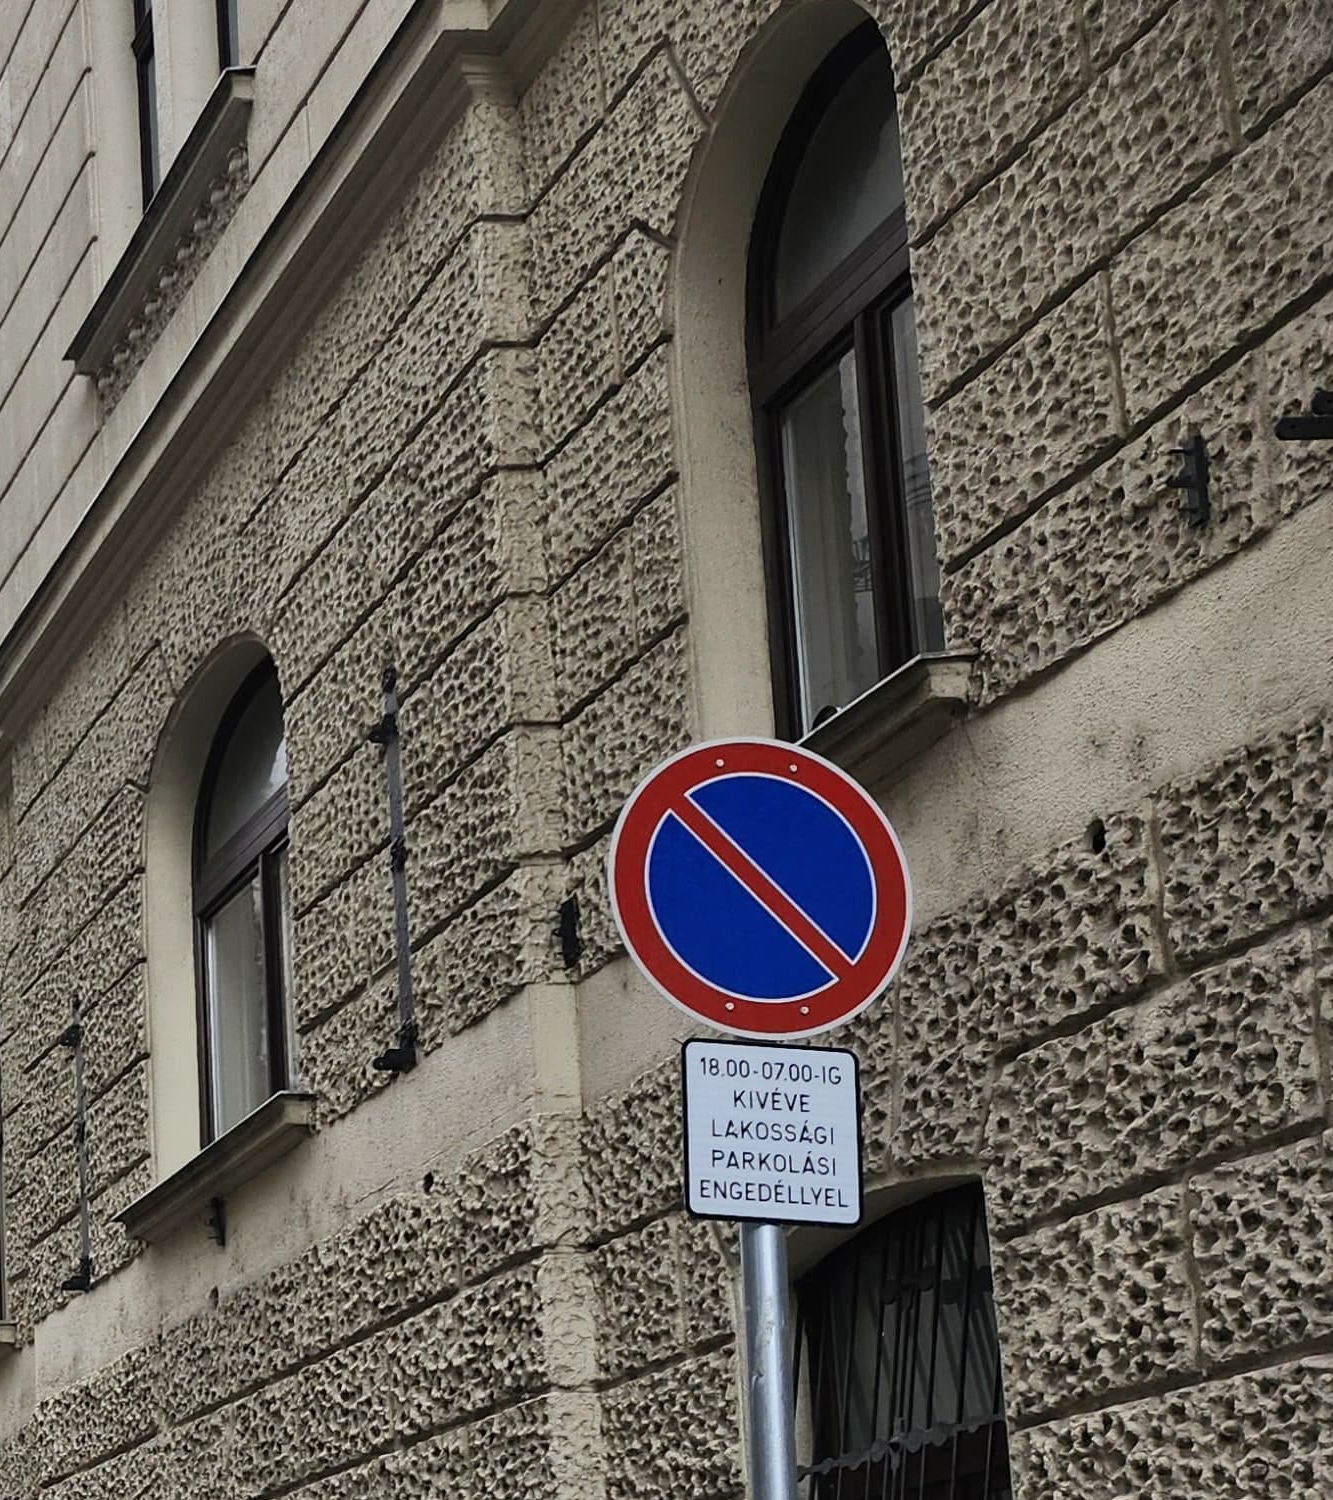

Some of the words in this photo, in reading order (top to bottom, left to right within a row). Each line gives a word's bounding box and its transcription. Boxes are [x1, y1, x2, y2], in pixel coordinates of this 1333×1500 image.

[733, 1088, 811, 1113] KIVÉVE
[711, 1119, 834, 1145] LAKOSSÁGI
[711, 1149, 836, 1177] PARKOLÁSI
[700, 1179, 849, 1208] ENGEDÉLLYEL
